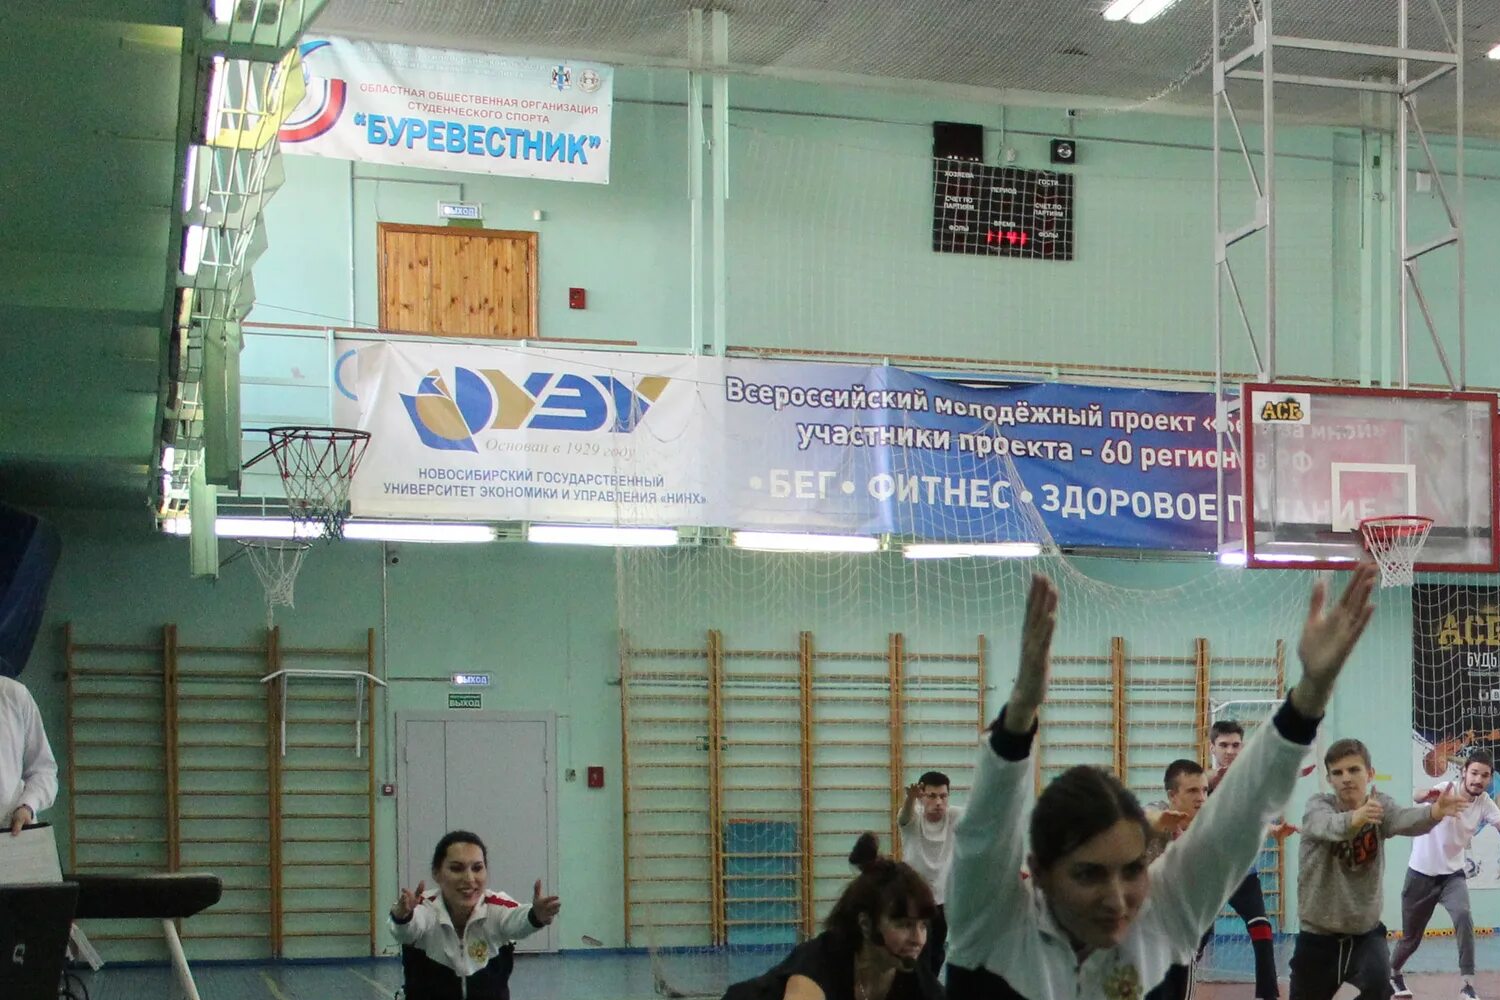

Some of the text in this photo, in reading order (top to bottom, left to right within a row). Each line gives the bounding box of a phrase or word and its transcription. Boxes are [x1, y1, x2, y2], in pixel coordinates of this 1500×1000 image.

[360, 82, 599, 115] ОБЛАСТНАЯ ОБЩЕСТВЕННАЯ ОРГАНИЗАЦИЯ
[408, 101, 550, 123] СТУДЕНЧЕСКОГО СПОРТА
[1038, 178, 1059, 186] ГОСТИ
[726, 375, 929, 411] Всероссийский
[935, 395, 1103, 428] молодёжный
[1110, 410, 1197, 434] проект
[486, 438, 636, 461] Основан в 1929 году
[796, 422, 951, 451] участники
[959, 432, 1073, 460] проекта
[1101, 440, 1132, 465] 60
[418, 467, 665, 488] НОВОСИБИРСКИЙ ГОСУДАРСТВЕННЫЙ
[384, 483, 707, 505] УНИВЕРСИТЕТ ЭКОНОМИКИ И УПРАВЛЕНИЯ «НИНХ»
[769, 468, 837, 500] БЕГ
[868, 472, 1011, 509] ФИТНЕС
[1041, 483, 1218, 522] ЗДОРОВОЕ
[1467, 652, 1497, 668] БУДЬ
[449, 699, 480, 707] ВЫХОД
